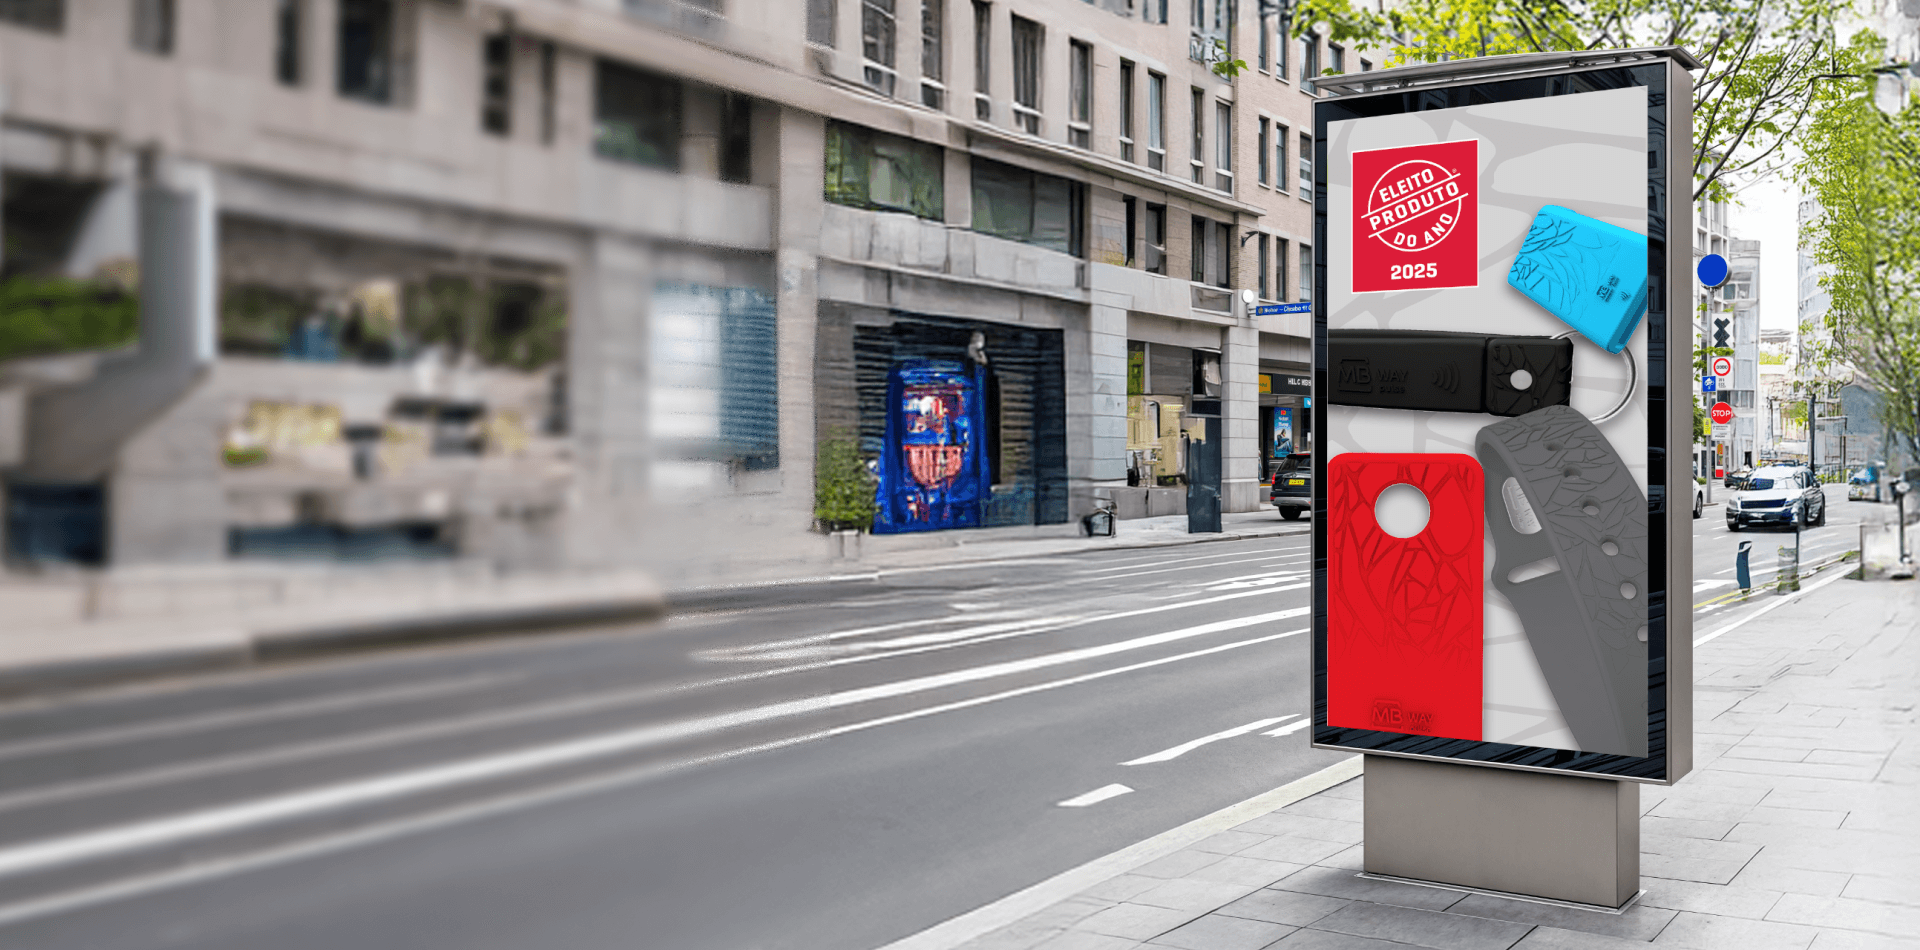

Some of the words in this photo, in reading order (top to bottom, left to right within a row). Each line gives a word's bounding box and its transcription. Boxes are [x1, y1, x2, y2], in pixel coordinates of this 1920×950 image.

[1379, 168, 1434, 203] ELEITO
[1369, 181, 1459, 231] PRODUTO
[1393, 232, 1417, 247] DO
[1423, 213, 1453, 244] ANO
[1391, 263, 1438, 280] 2025
[1338, 365, 1372, 385] MB
[1377, 368, 1409, 382] WAY
[1712, 409, 1731, 417] STOP
[1372, 706, 1403, 724] MB
[1407, 712, 1433, 723] WAY
